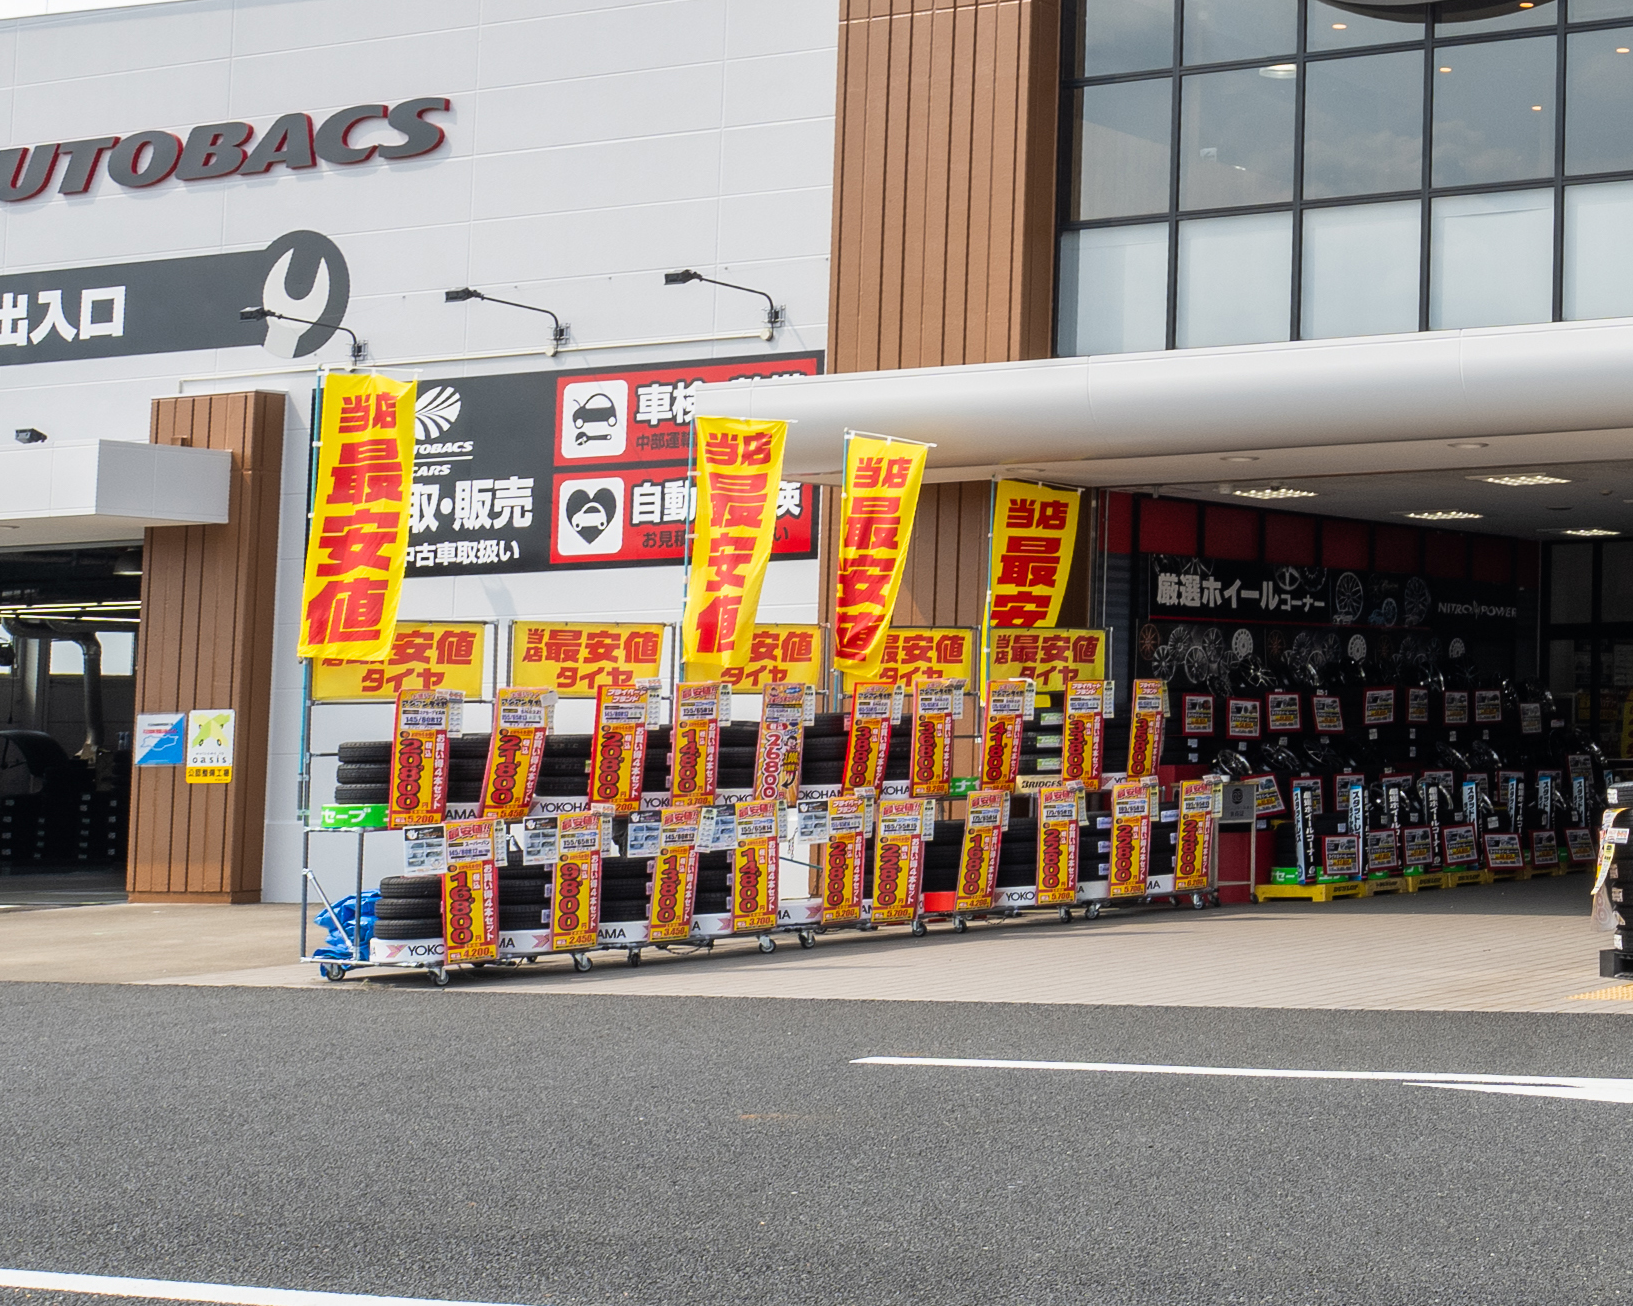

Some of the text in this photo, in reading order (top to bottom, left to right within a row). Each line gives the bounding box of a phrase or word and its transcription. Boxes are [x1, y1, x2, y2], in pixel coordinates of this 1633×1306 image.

[338, 393, 397, 435] 当店
[705, 431, 772, 468] 当店
[854, 456, 912, 491] 当店
[409, 476, 534, 533] 取・販売
[1006, 497, 1069, 532] 当店
[305, 439, 403, 643] 最安値
[694, 472, 763, 654] 最安値
[835, 496, 901, 663] 最安値
[1156, 573, 1325, 612] 厳選ホイールコーナー
[523, 628, 658, 665] 当店 最安値
[994, 635, 1099, 664] 当店 最安値
[361, 668, 445, 693] タイヤ
[556, 668, 634, 690] タイヤ
[720, 666, 788, 686] タイヤ
[192, 755, 226, 763] oasis
